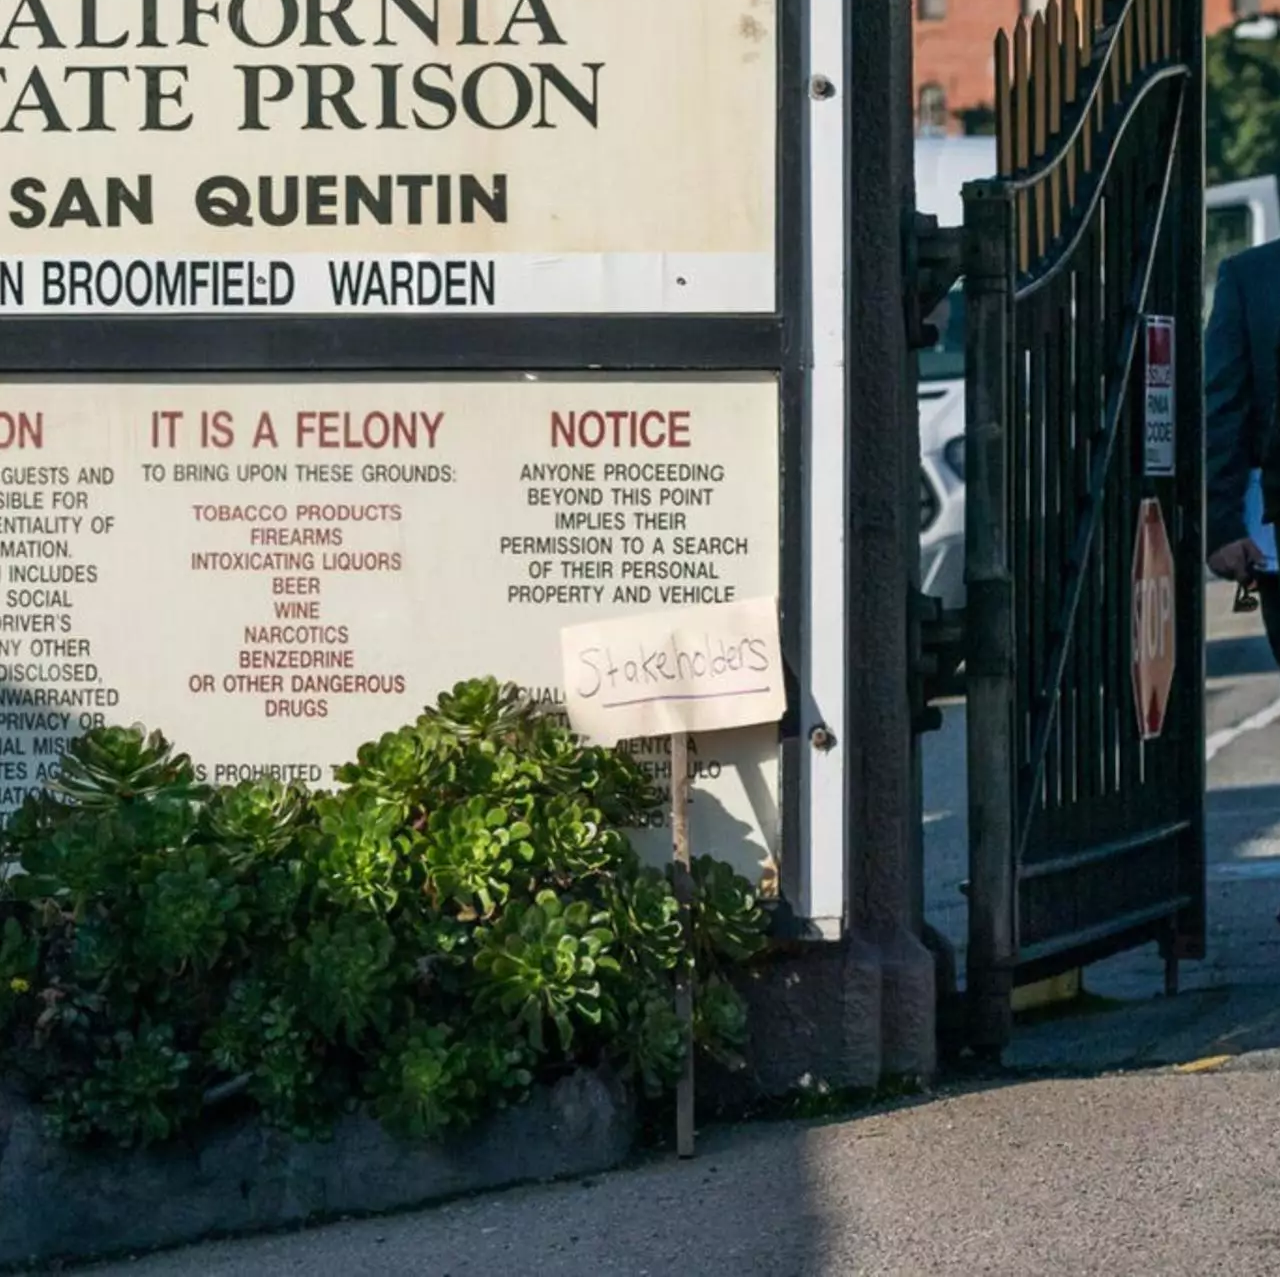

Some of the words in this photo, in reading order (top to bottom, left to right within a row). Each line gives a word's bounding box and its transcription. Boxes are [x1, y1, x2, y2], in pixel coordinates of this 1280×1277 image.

[233, 61, 606, 131] PRISON
[8, 173, 154, 229] SAN
[194, 173, 508, 228] QUENTIN
[42, 259, 295, 307] BROOMFIELD
[328, 260, 495, 306] WARDEN
[152, 410, 184, 449] IT
[201, 410, 235, 449] IS
[252, 411, 279, 449] A
[296, 410, 445, 450] FELONY
[551, 410, 691, 449] NOTICE
[0, 466, 70, 486] GUESTS
[77, 466, 115, 486] AND
[141, 463, 166, 483] TO
[173, 463, 230, 483] BRING
[236, 463, 288, 483] UPON
[295, 463, 353, 483] THESE
[361, 463, 456, 484] GROUNDS:
[519, 463, 596, 483] ANYONE
[603, 462, 725, 482] PROCEEDING
[52, 491, 89, 510] FOR
[527, 487, 604, 507] BEYOND
[610, 487, 652, 507] THIS
[659, 487, 714, 507] POINT
[192, 504, 288, 523] TOBACCO
[296, 503, 402, 522] PRODUCTS
[554, 511, 626, 531] IMPLIES
[633, 511, 687, 531] THEIR
[90, 515, 115, 535] OF
[250, 527, 343, 547] FIREARMS
[500, 536, 613, 555] PERMISSION
[620, 536, 645, 555] TO
[651, 536, 665, 555] A
[672, 536, 748, 556] SEARCH
[191, 551, 315, 572] INTOXICATING
[322, 551, 402, 572] LIQUORS
[528, 560, 553, 580] OF
[560, 560, 614, 579] THEIR
[621, 560, 720, 580] PERSONAL
[8, 564, 98, 584] INCLUDES
[272, 576, 321, 595] BEER
[507, 584, 605, 604] PROPERTY
[612, 585, 652, 604] AND
[658, 585, 735, 605] VEHICLE
[5, 588, 73, 609] SOCIAL
[273, 601, 321, 620] WINE
[244, 625, 349, 645] NARCOTICS
[29, 637, 91, 658] OTHER
[238, 649, 354, 669] BENZEDRINE
[578, 634, 770, 698] Stakeholders
[188, 674, 216, 694] OR
[222, 674, 284, 694] OTHER
[291, 674, 406, 695] DANGEROUS
[264, 698, 329, 718] DRUGS
